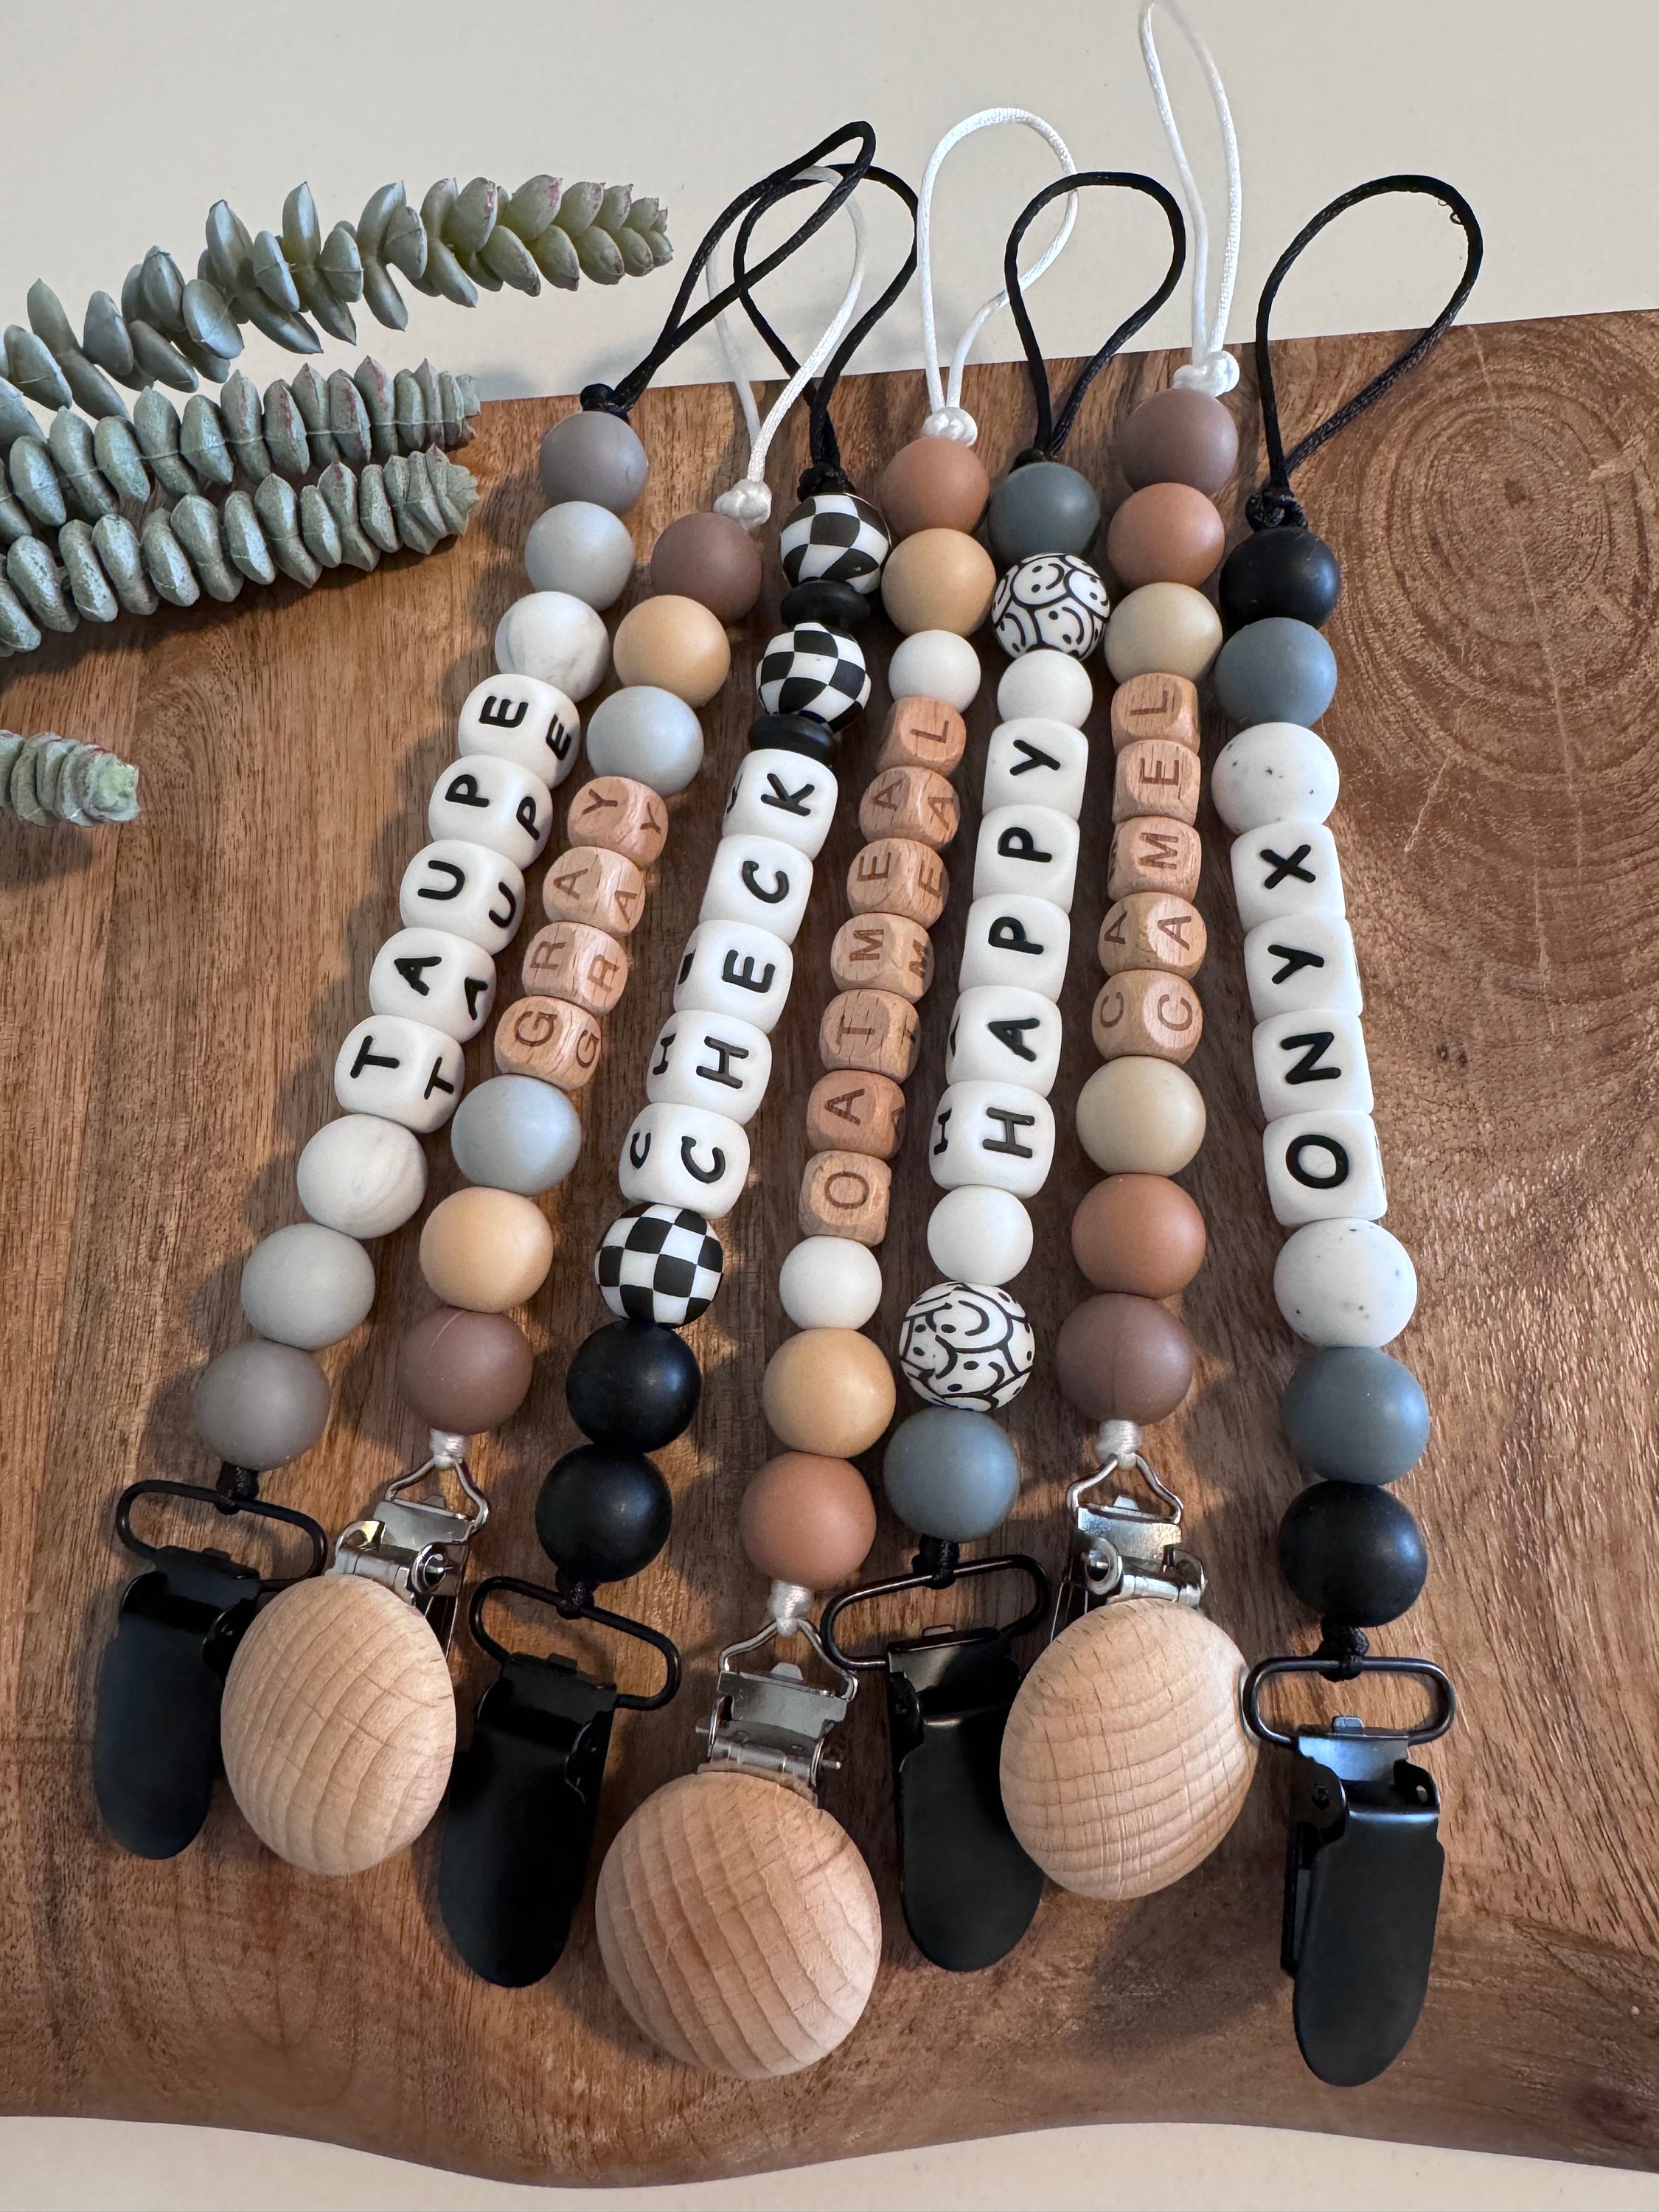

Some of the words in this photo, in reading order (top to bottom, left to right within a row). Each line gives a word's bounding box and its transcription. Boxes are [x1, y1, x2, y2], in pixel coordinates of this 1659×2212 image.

[349, 695, 529, 1079] TAUPE
[515, 787, 619, 1048] GRAY
[681, 773, 815, 1184] CHECK
[823, 720, 950, 1210] OATMEAL
[982, 739, 1061, 1159] HAPPY
[1128, 689, 1194, 1032] CAMEL
[1259, 844, 1349, 1190] ONYX
